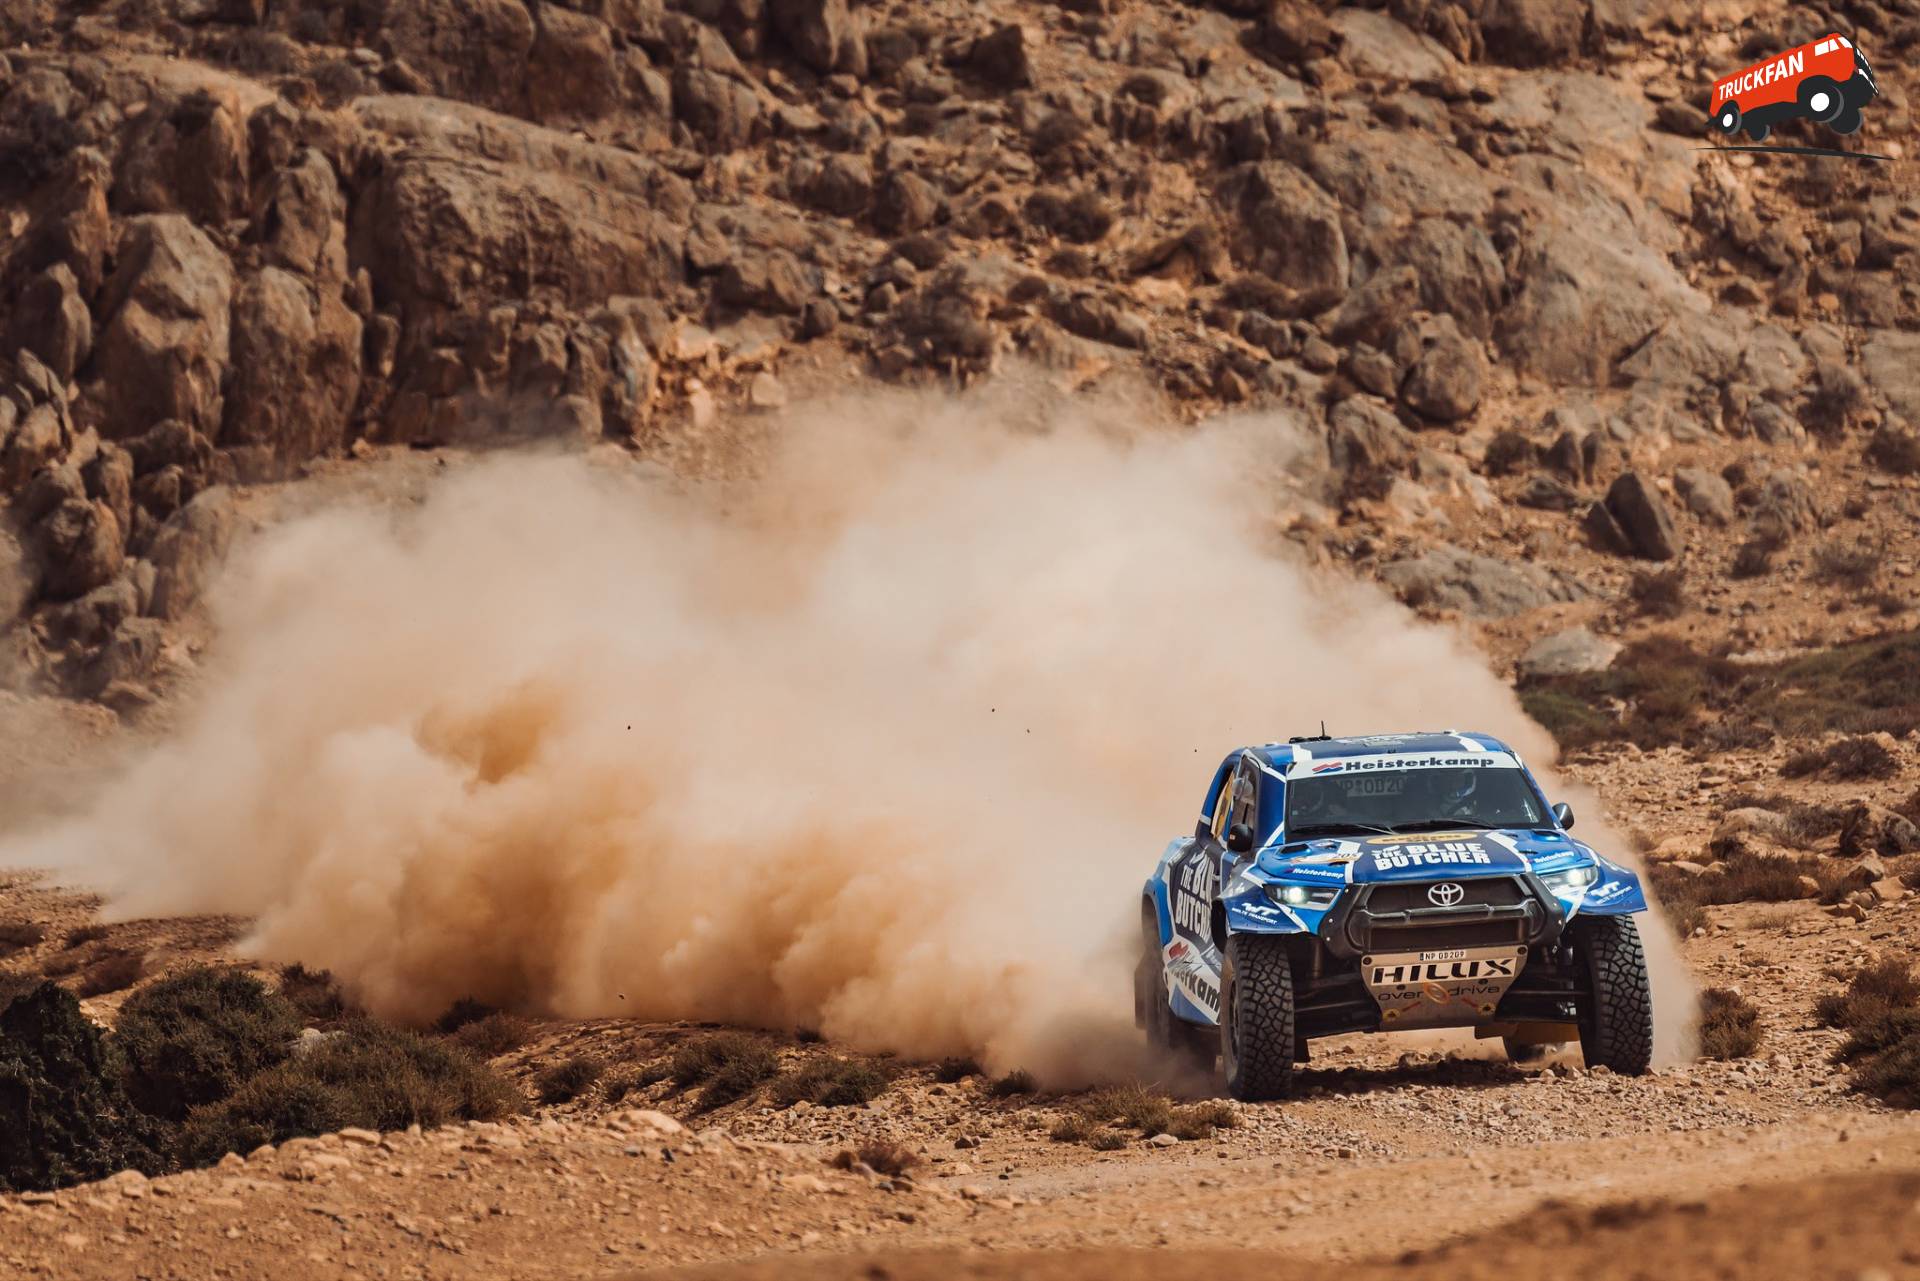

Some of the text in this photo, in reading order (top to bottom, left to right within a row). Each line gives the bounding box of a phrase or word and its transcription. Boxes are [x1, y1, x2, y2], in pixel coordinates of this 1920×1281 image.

[1345, 757, 1494, 771] Heisterkamp
[1405, 843, 1486, 854] BLUE
[1374, 851, 1491, 871] BUTCHER
[1181, 853, 1214, 909] THE BLU
[1292, 868, 1344, 879] Heisterkamp
[1373, 959, 1513, 983] HILUX
[1378, 985, 1501, 1001] over drive
